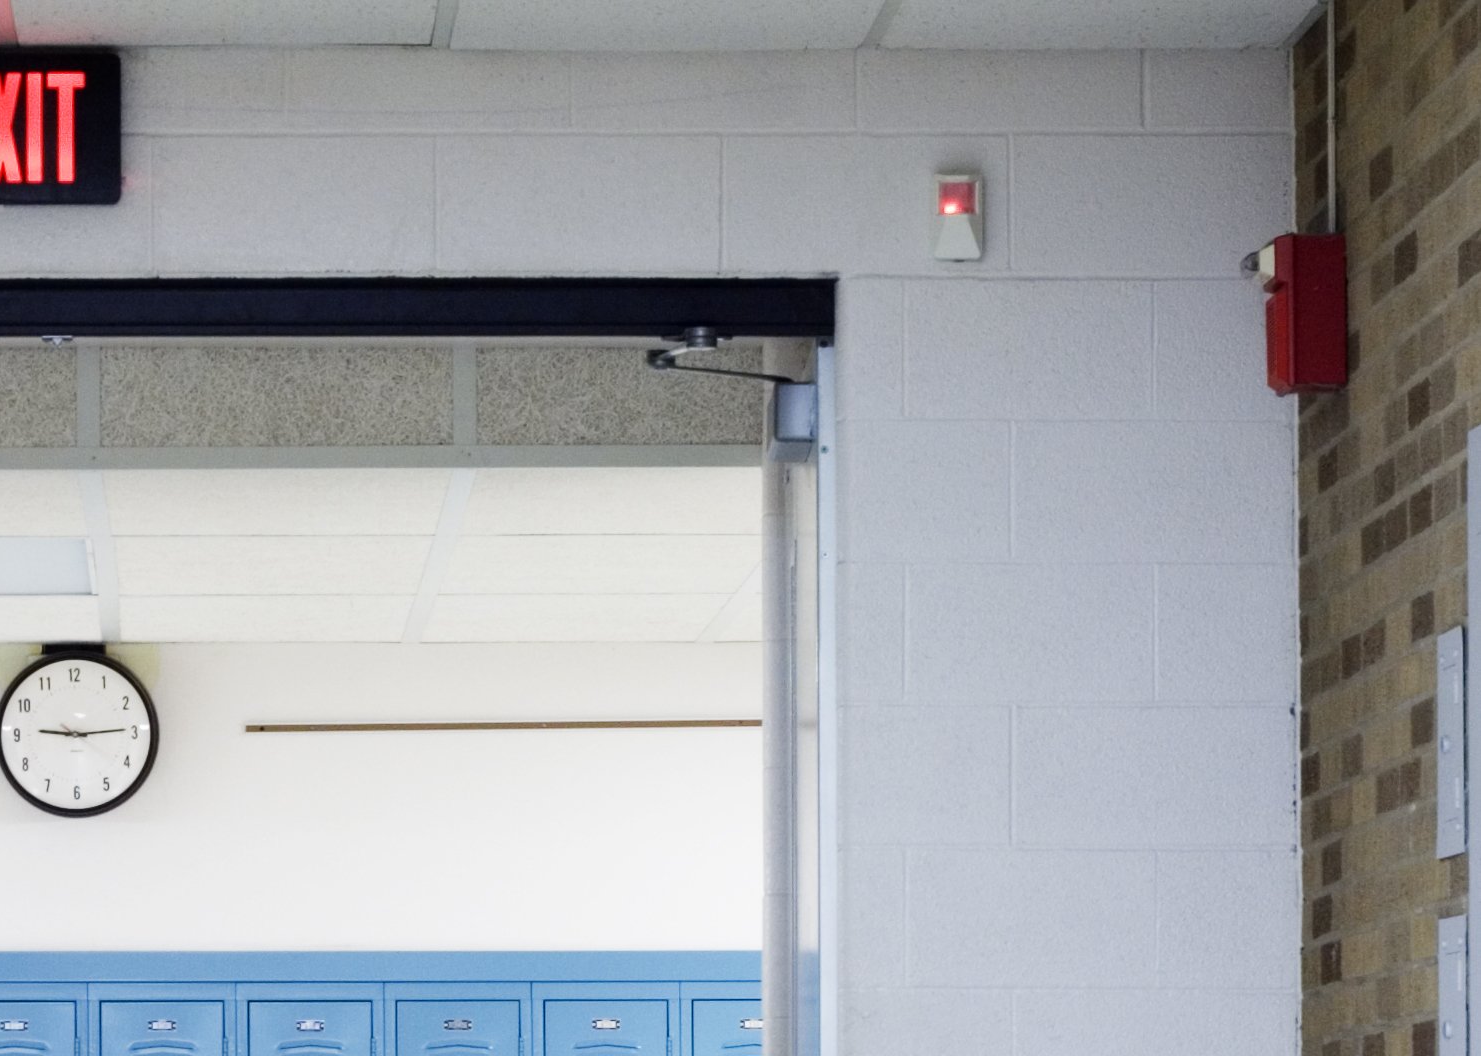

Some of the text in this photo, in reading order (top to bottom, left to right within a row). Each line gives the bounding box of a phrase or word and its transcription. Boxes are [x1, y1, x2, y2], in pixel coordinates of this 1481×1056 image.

[68, 668, 81, 682] 12
[101, 676, 106, 688] 1
[39, 677, 51, 690] 11
[18, 699, 31, 712] 10
[122, 696, 130, 710] 2
[13, 728, 21, 742] 9
[130, 725, 139, 739] 3
[21, 757, 29, 771] 8
[123, 755, 131, 767] 4
[44, 779, 51, 792] 7
[102, 777, 110, 791] 5
[73, 786, 81, 800] 6
